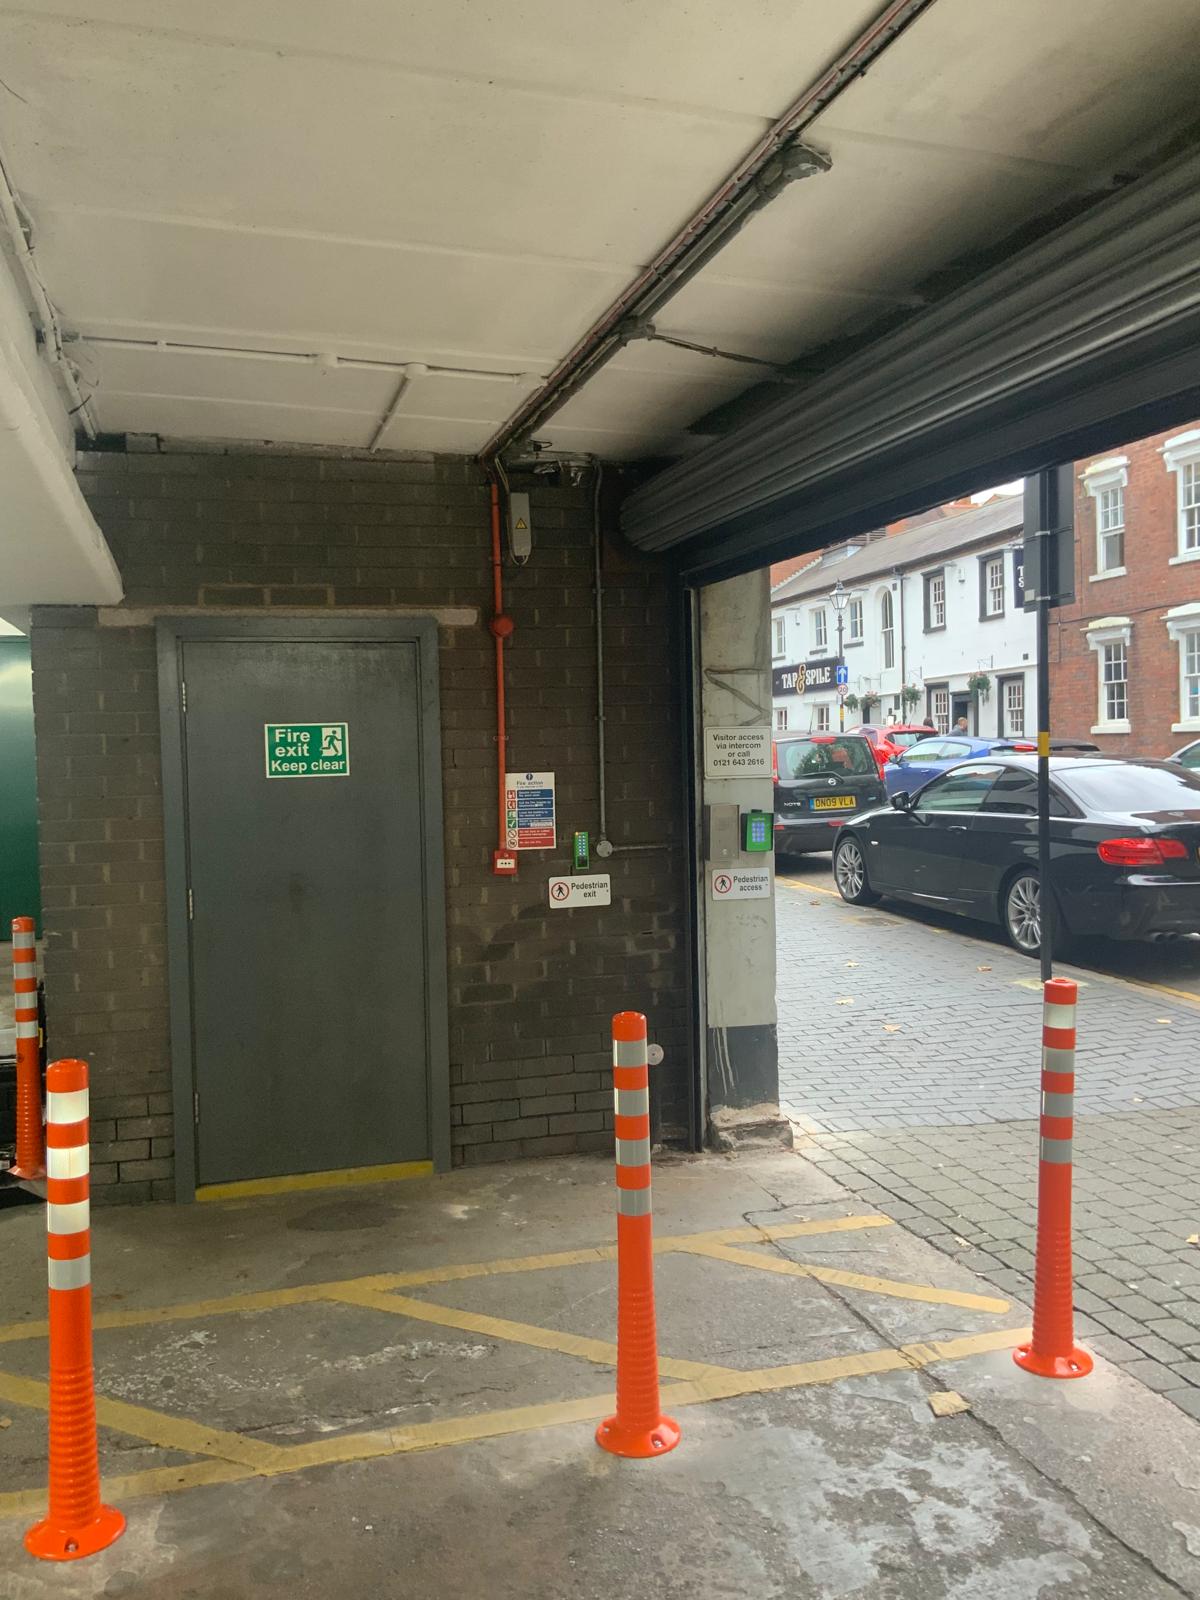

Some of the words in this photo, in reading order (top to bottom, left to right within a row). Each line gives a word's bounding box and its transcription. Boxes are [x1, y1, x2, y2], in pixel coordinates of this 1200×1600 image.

[781, 672, 798, 689] TAP
[796, 664, 806, 695] &
[805, 667, 831, 686] SPILE
[275, 729, 310, 743] Fire
[275, 743, 310, 757] exit
[271, 760, 308, 773] Keep
[311, 759, 345, 771] clear
[838, 796, 854, 807] VLA
[733, 875, 769, 883] Pedestrian
[571, 881, 608, 890] Pedestrian
[583, 890, 597, 898] exit
